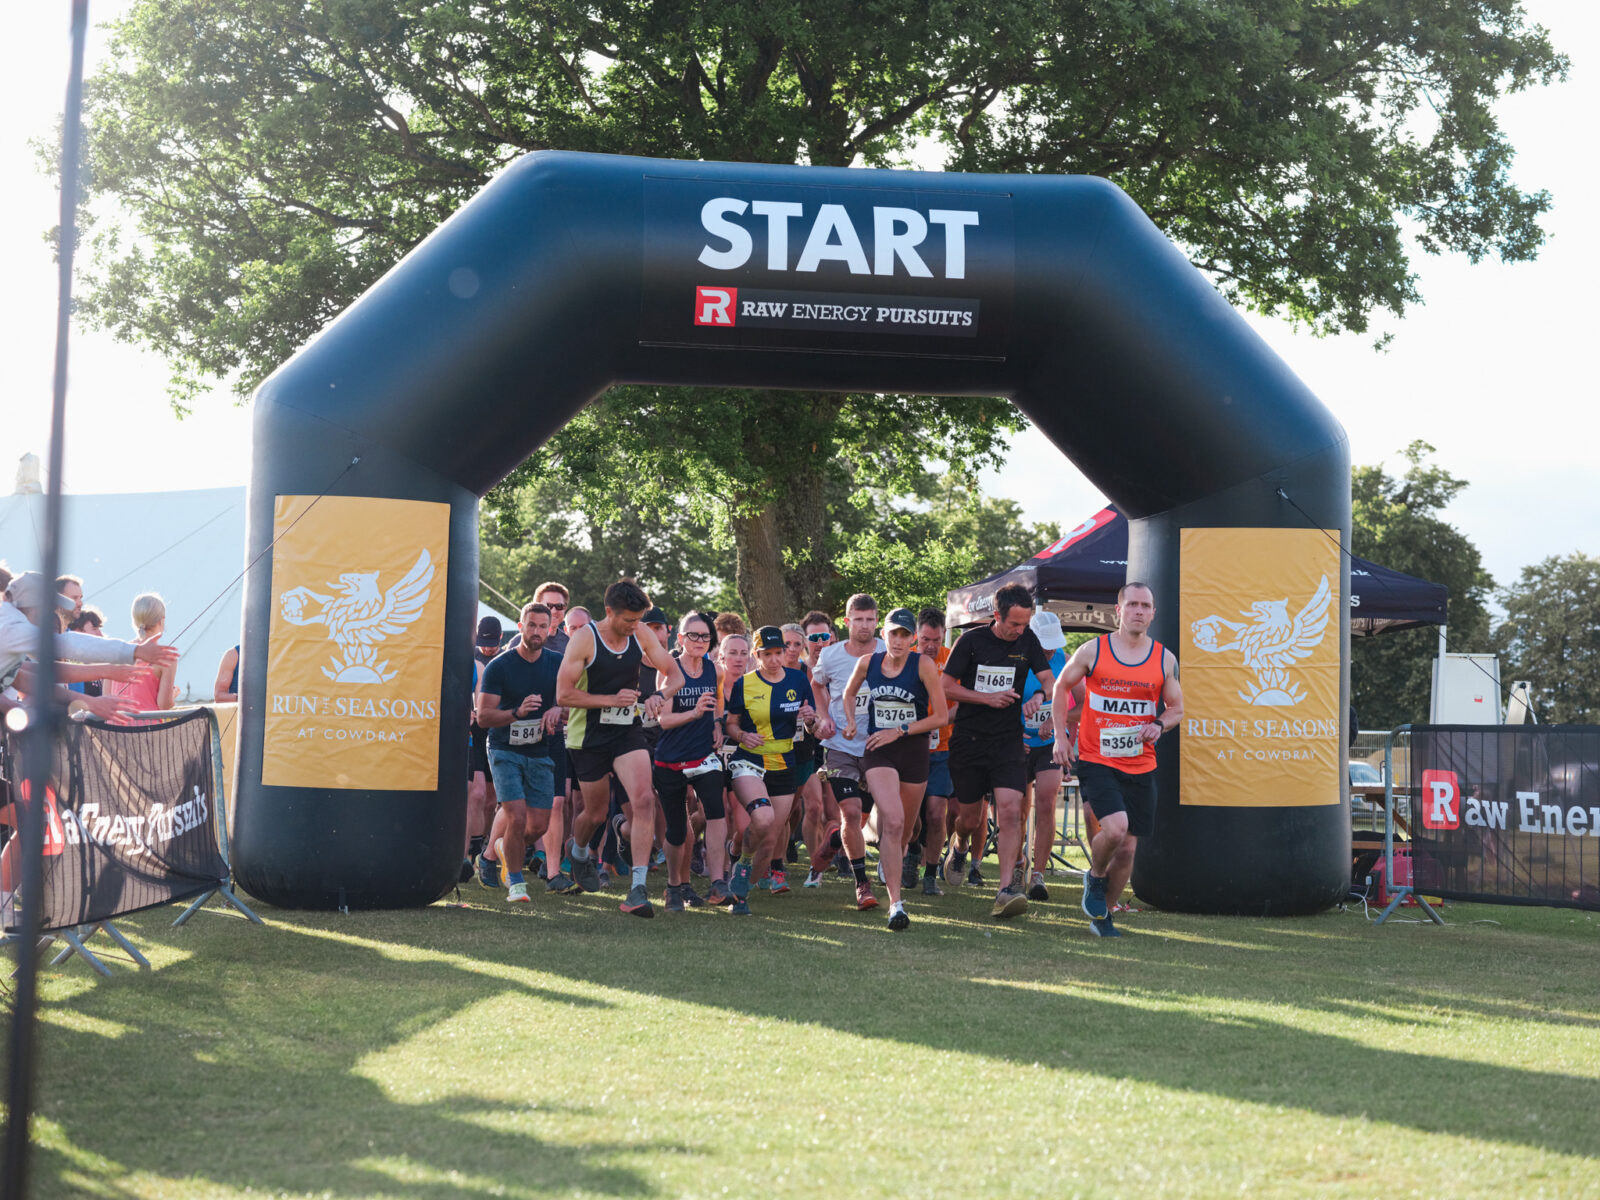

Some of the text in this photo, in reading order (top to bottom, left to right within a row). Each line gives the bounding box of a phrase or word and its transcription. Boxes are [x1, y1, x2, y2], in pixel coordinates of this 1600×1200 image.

[698, 197, 979, 280] START
[742, 301, 788, 318] RAW
[792, 304, 871, 322] ENERGY
[876, 307, 973, 326] PURSUITS
[987, 674, 1005, 687] 168
[1101, 685, 1131, 693] HOSPICE
[272, 695, 318, 715] RUN
[334, 697, 437, 720] SEASONS
[1103, 699, 1148, 714] MATT
[884, 709, 906, 721] 376
[297, 728, 407, 742] AT COWDRAY
[522, 728, 535, 739] 84
[1187, 719, 1236, 737] RUN
[1253, 719, 1337, 738] SEASONS
[1111, 735, 1134, 750] 356
[1217, 750, 1316, 761] AT COWDRAY
[1430, 781, 1509, 830] Raw
